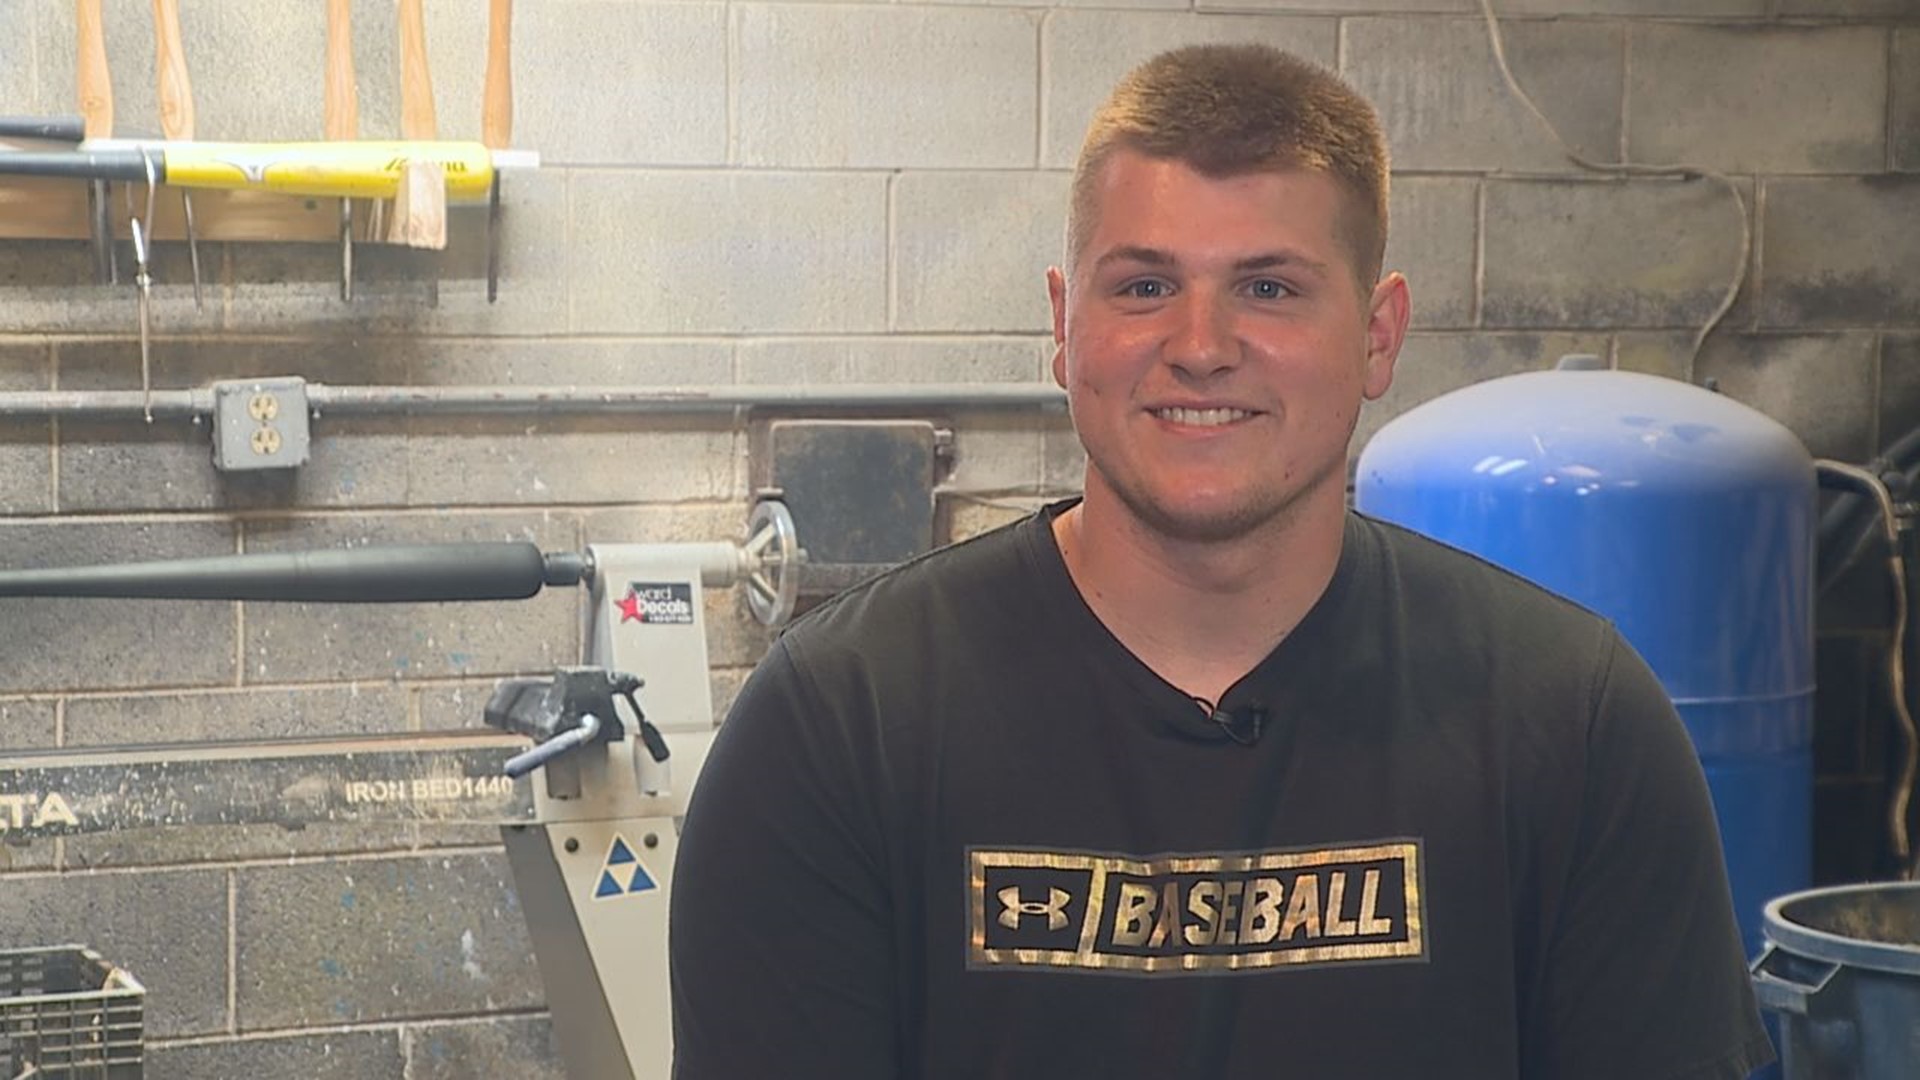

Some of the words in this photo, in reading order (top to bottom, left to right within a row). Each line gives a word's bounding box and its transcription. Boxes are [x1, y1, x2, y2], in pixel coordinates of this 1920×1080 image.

[0, 791, 80, 829] TA
[345, 780, 405, 803] IRON
[1111, 869, 1393, 948] BASEBALL
